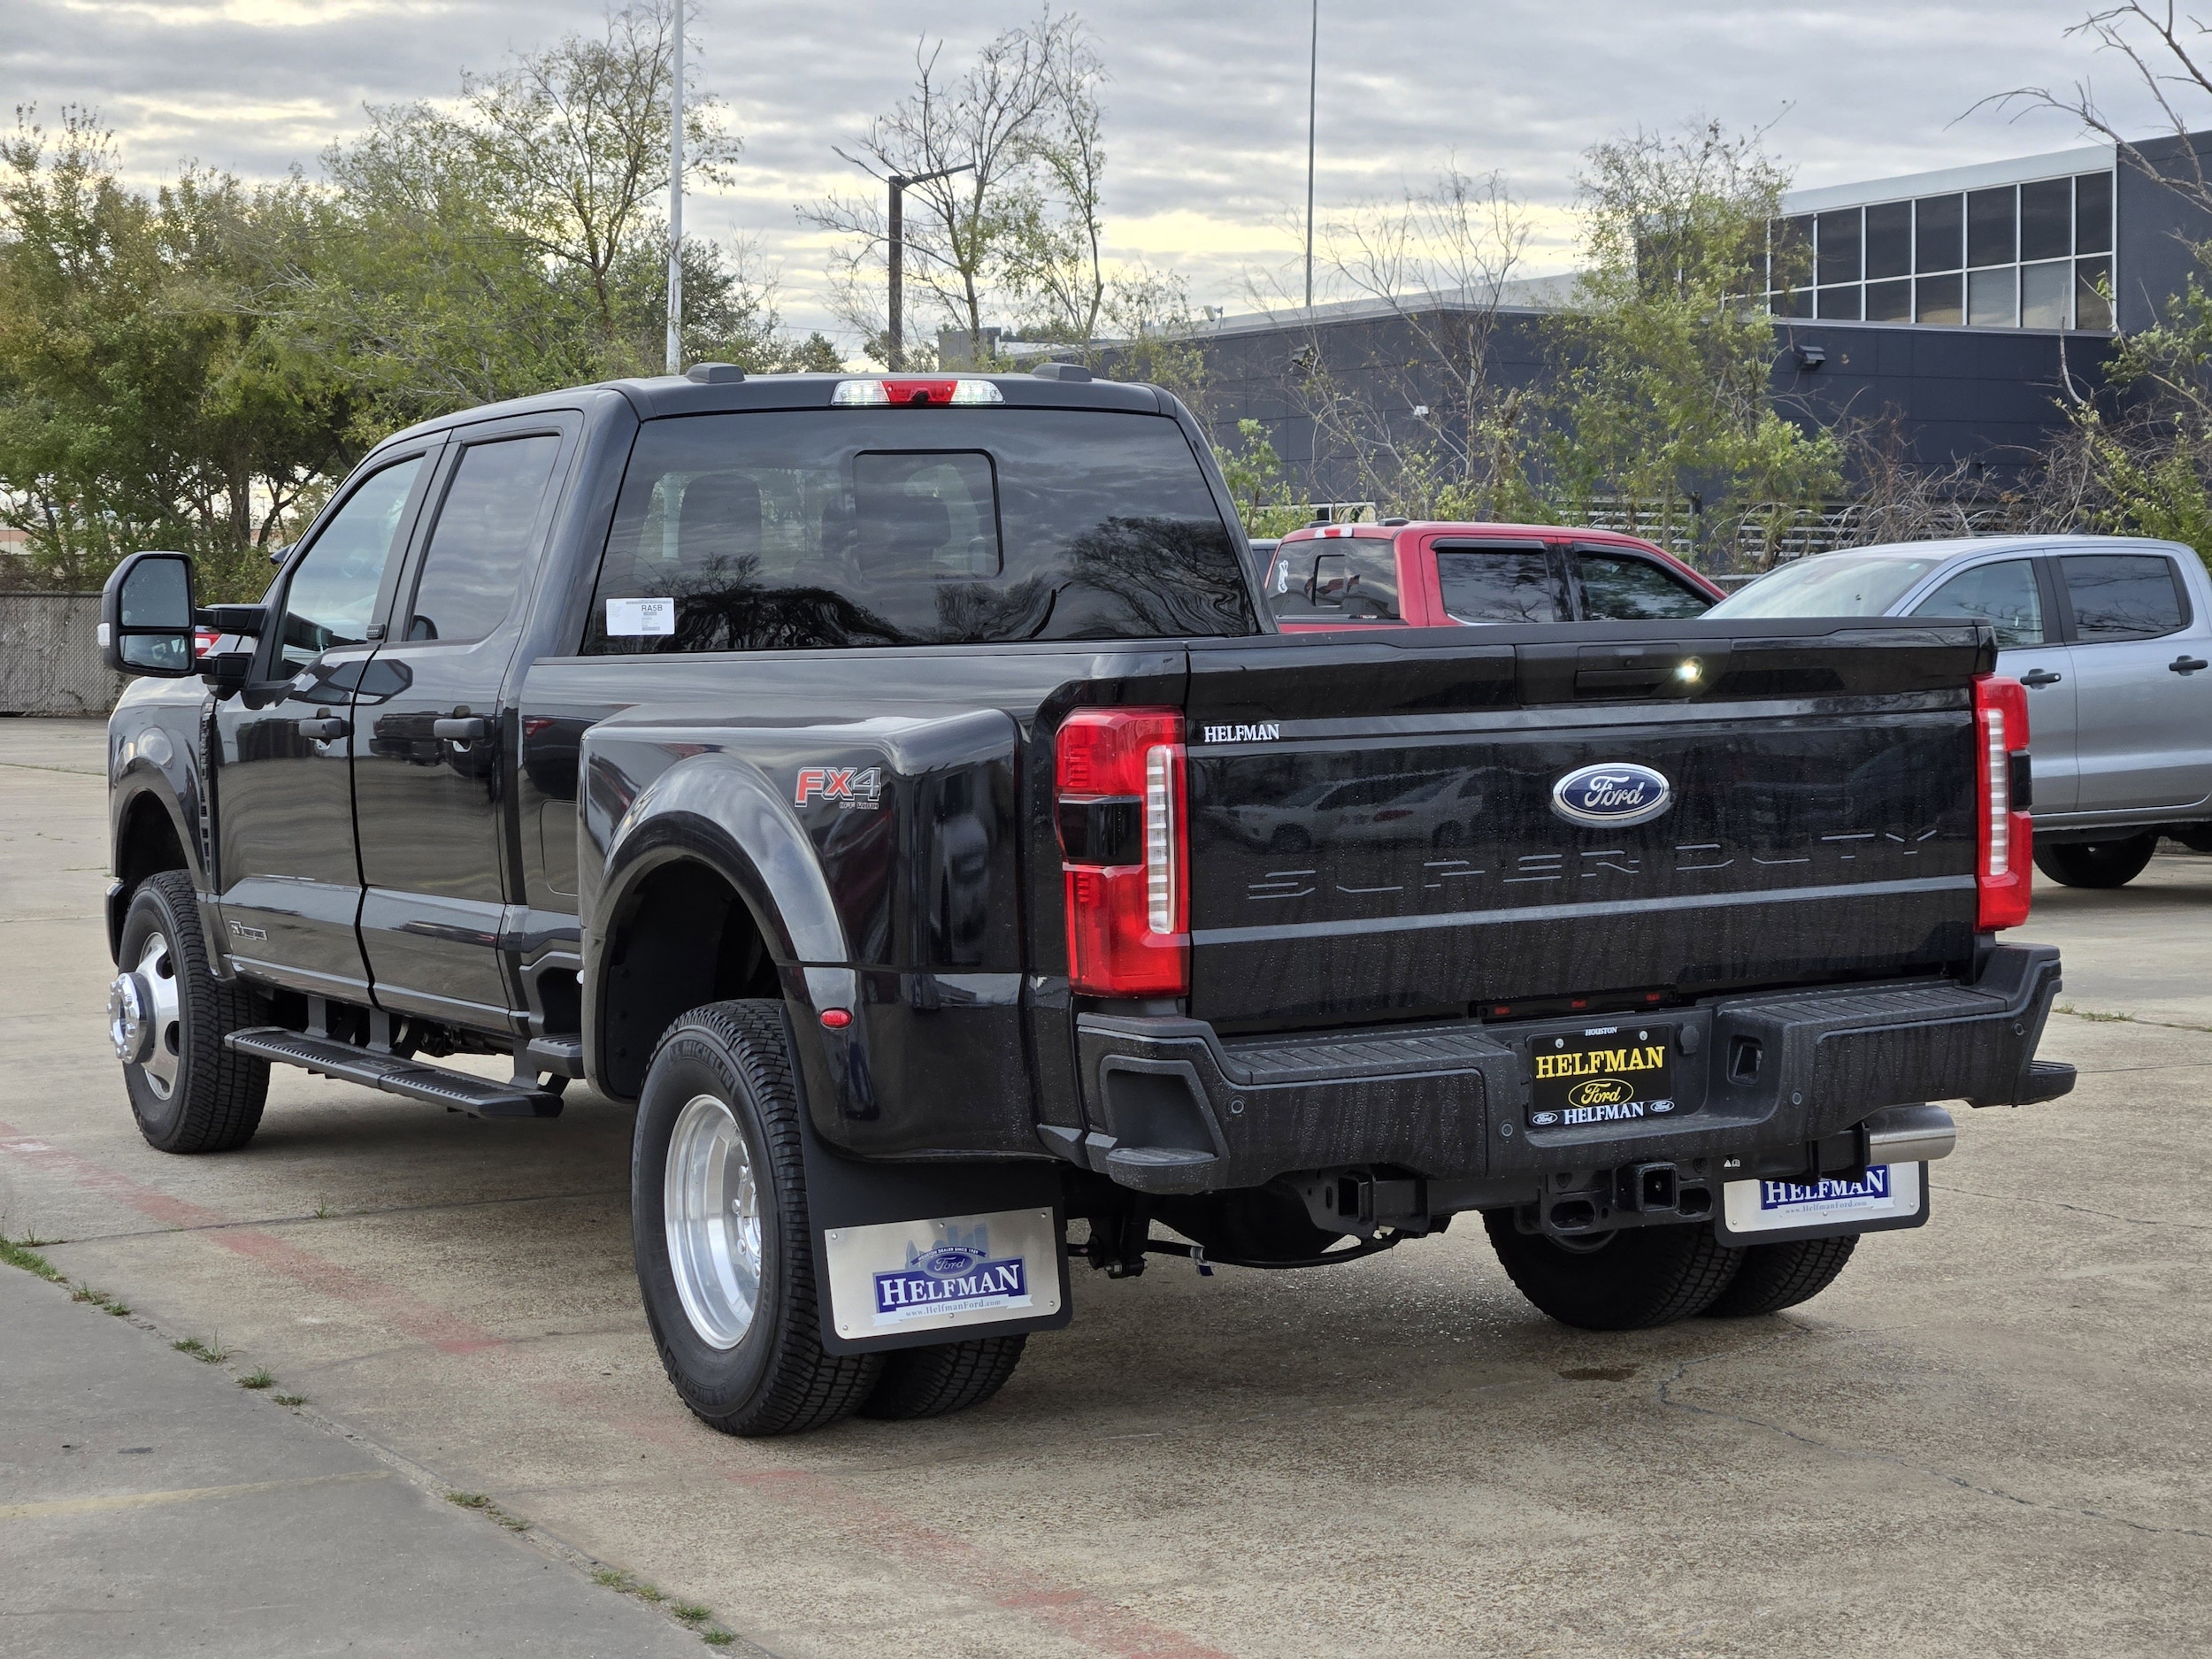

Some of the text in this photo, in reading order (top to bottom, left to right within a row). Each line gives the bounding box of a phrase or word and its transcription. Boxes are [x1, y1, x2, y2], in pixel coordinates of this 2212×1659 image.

[1204, 724, 1279, 742] HELFMAN
[795, 767, 881, 807] FX4
[1584, 775, 1645, 808] Ford
[1248, 830, 1937, 900] SUPER DUTY
[1585, 1026, 1618, 1036] HOUSTON
[682, 1040, 735, 1091] MICHELIN
[1535, 1046, 1665, 1079] HELFMAN
[1580, 1082, 1622, 1104] Ford
[1563, 1102, 1645, 1125] HELFMAN
[1765, 1170, 1885, 1204] HELFMAN
[1786, 1200, 1867, 1214] www.HelfmanFord.com
[934, 1256, 965, 1271] Ford
[880, 1264, 1019, 1306] HELFMAN
[905, 1299, 1002, 1317] www.HelfmanFord.com
